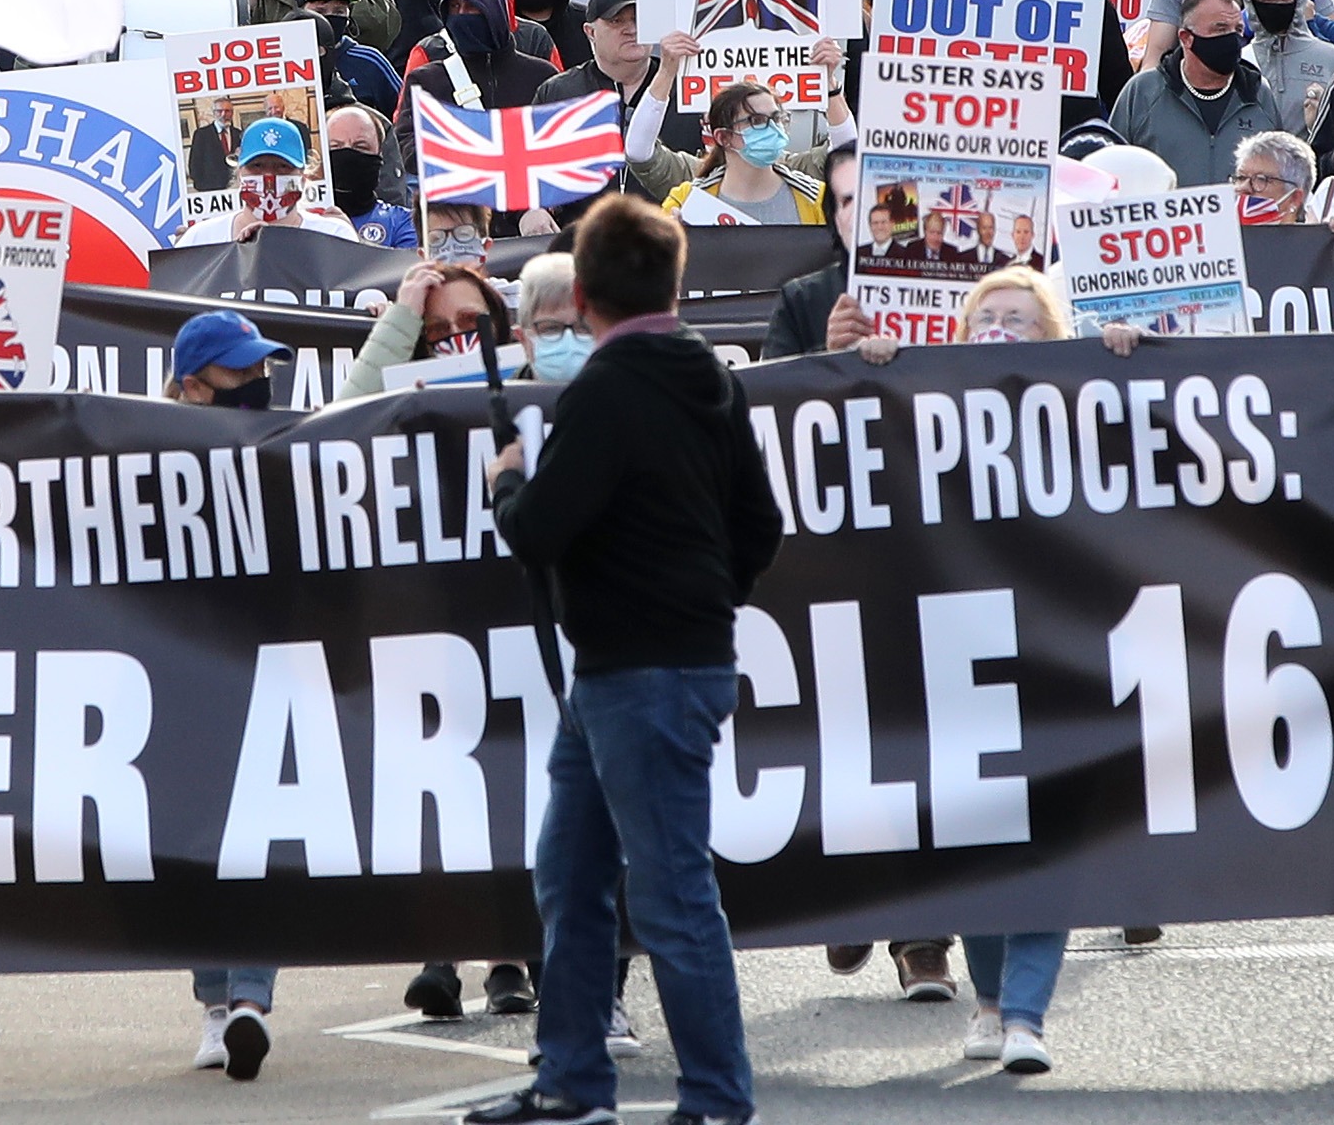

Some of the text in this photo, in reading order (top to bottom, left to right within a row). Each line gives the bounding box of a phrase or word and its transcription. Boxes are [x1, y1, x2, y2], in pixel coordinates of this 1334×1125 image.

[199, 37, 283, 65] JOE
[696, 47, 812, 69] TO SAVE THE
[174, 59, 315, 94] BIDEN
[681, 73, 822, 106] PECE
[878, 62, 974, 87] ULSTER
[982, 68, 1045, 91] SAYS
[903, 92, 1021, 130] STOP!
[866, 129, 1049, 159] IGNORING OUR VOICE
[869, 159, 915, 173] EUROPE
[991, 167, 1043, 179] IRELAND
[188, 184, 327, 215] IS AN OF
[1070, 194, 1221, 229] ULSTER SAYS
[5, 245, 57, 269] PROTOCOL
[1099, 223, 1205, 265] STOP!
[949, 261, 967, 271] ARE
[969, 263, 989, 273] NOT
[1071, 259, 1237, 294] IGNORING OUR VOICE
[857, 285, 890, 305] IT'S
[898, 288, 943, 308] TIME
[1189, 287, 1237, 301] IRELAND
[874, 311, 959, 345] ISTEN
[289, 427, 533, 573] IRELA
[750, 397, 891, 535] ACE
[913, 375, 1303, 525] PROCESS:
[216, 590, 1031, 878] ARTCLE
[1108, 573, 1333, 835] 16
